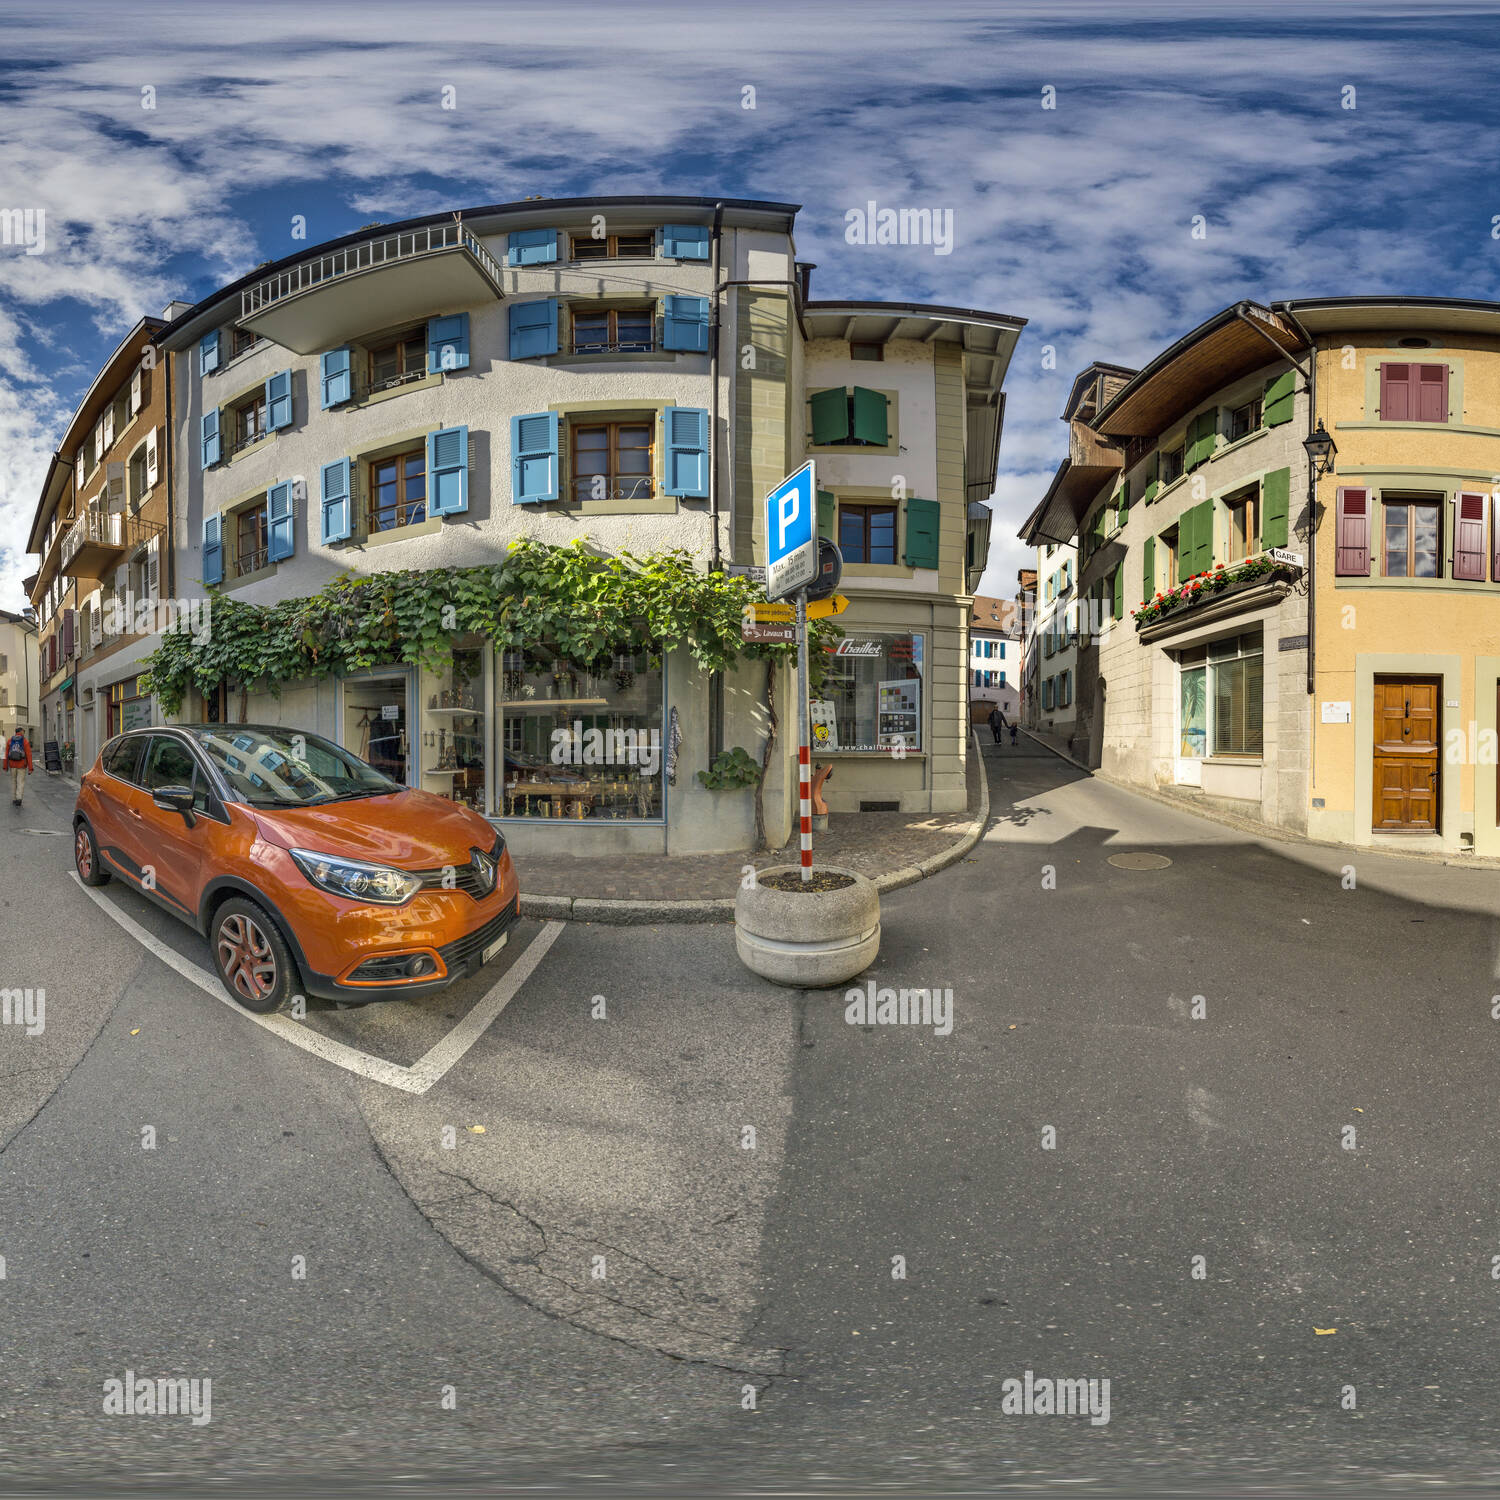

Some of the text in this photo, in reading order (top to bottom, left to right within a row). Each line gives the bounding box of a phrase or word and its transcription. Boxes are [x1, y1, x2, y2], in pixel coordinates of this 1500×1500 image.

[778, 487, 800, 551] P
[1275, 550, 1297, 563] GARE
[763, 629, 784, 637] Lavaux
[836, 638, 881, 656] Chaillet
